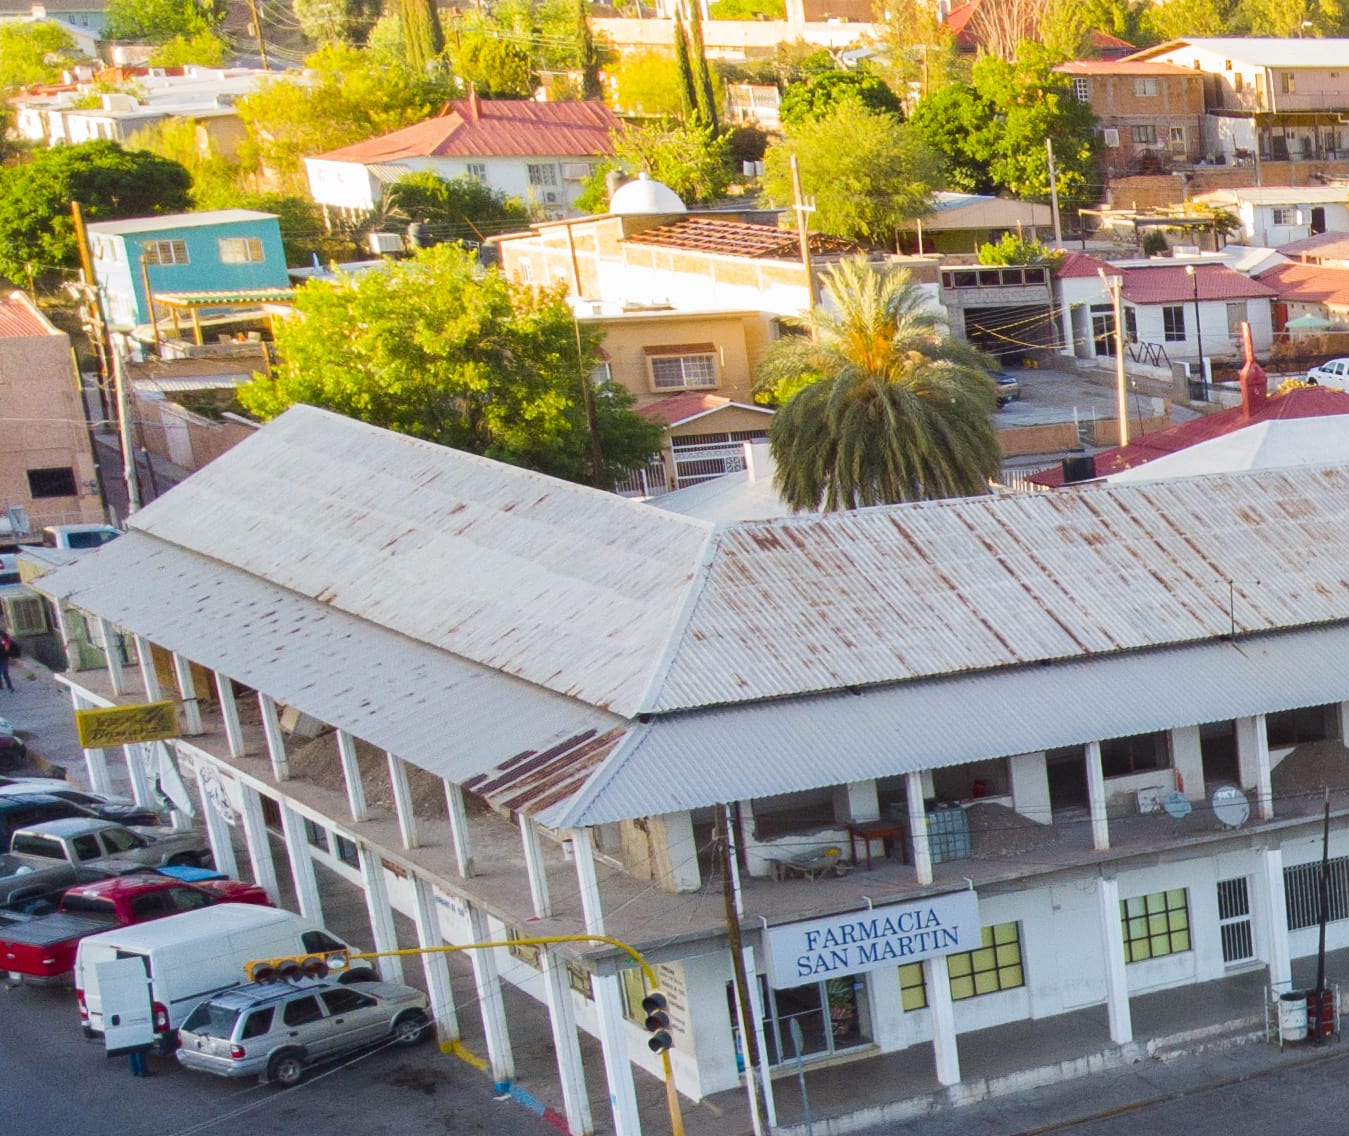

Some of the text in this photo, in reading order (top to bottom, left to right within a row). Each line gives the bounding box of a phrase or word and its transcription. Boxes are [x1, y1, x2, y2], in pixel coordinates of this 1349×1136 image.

[797, 926, 960, 977] SAN MARTIN
[805, 908, 942, 952] FARMACIA
